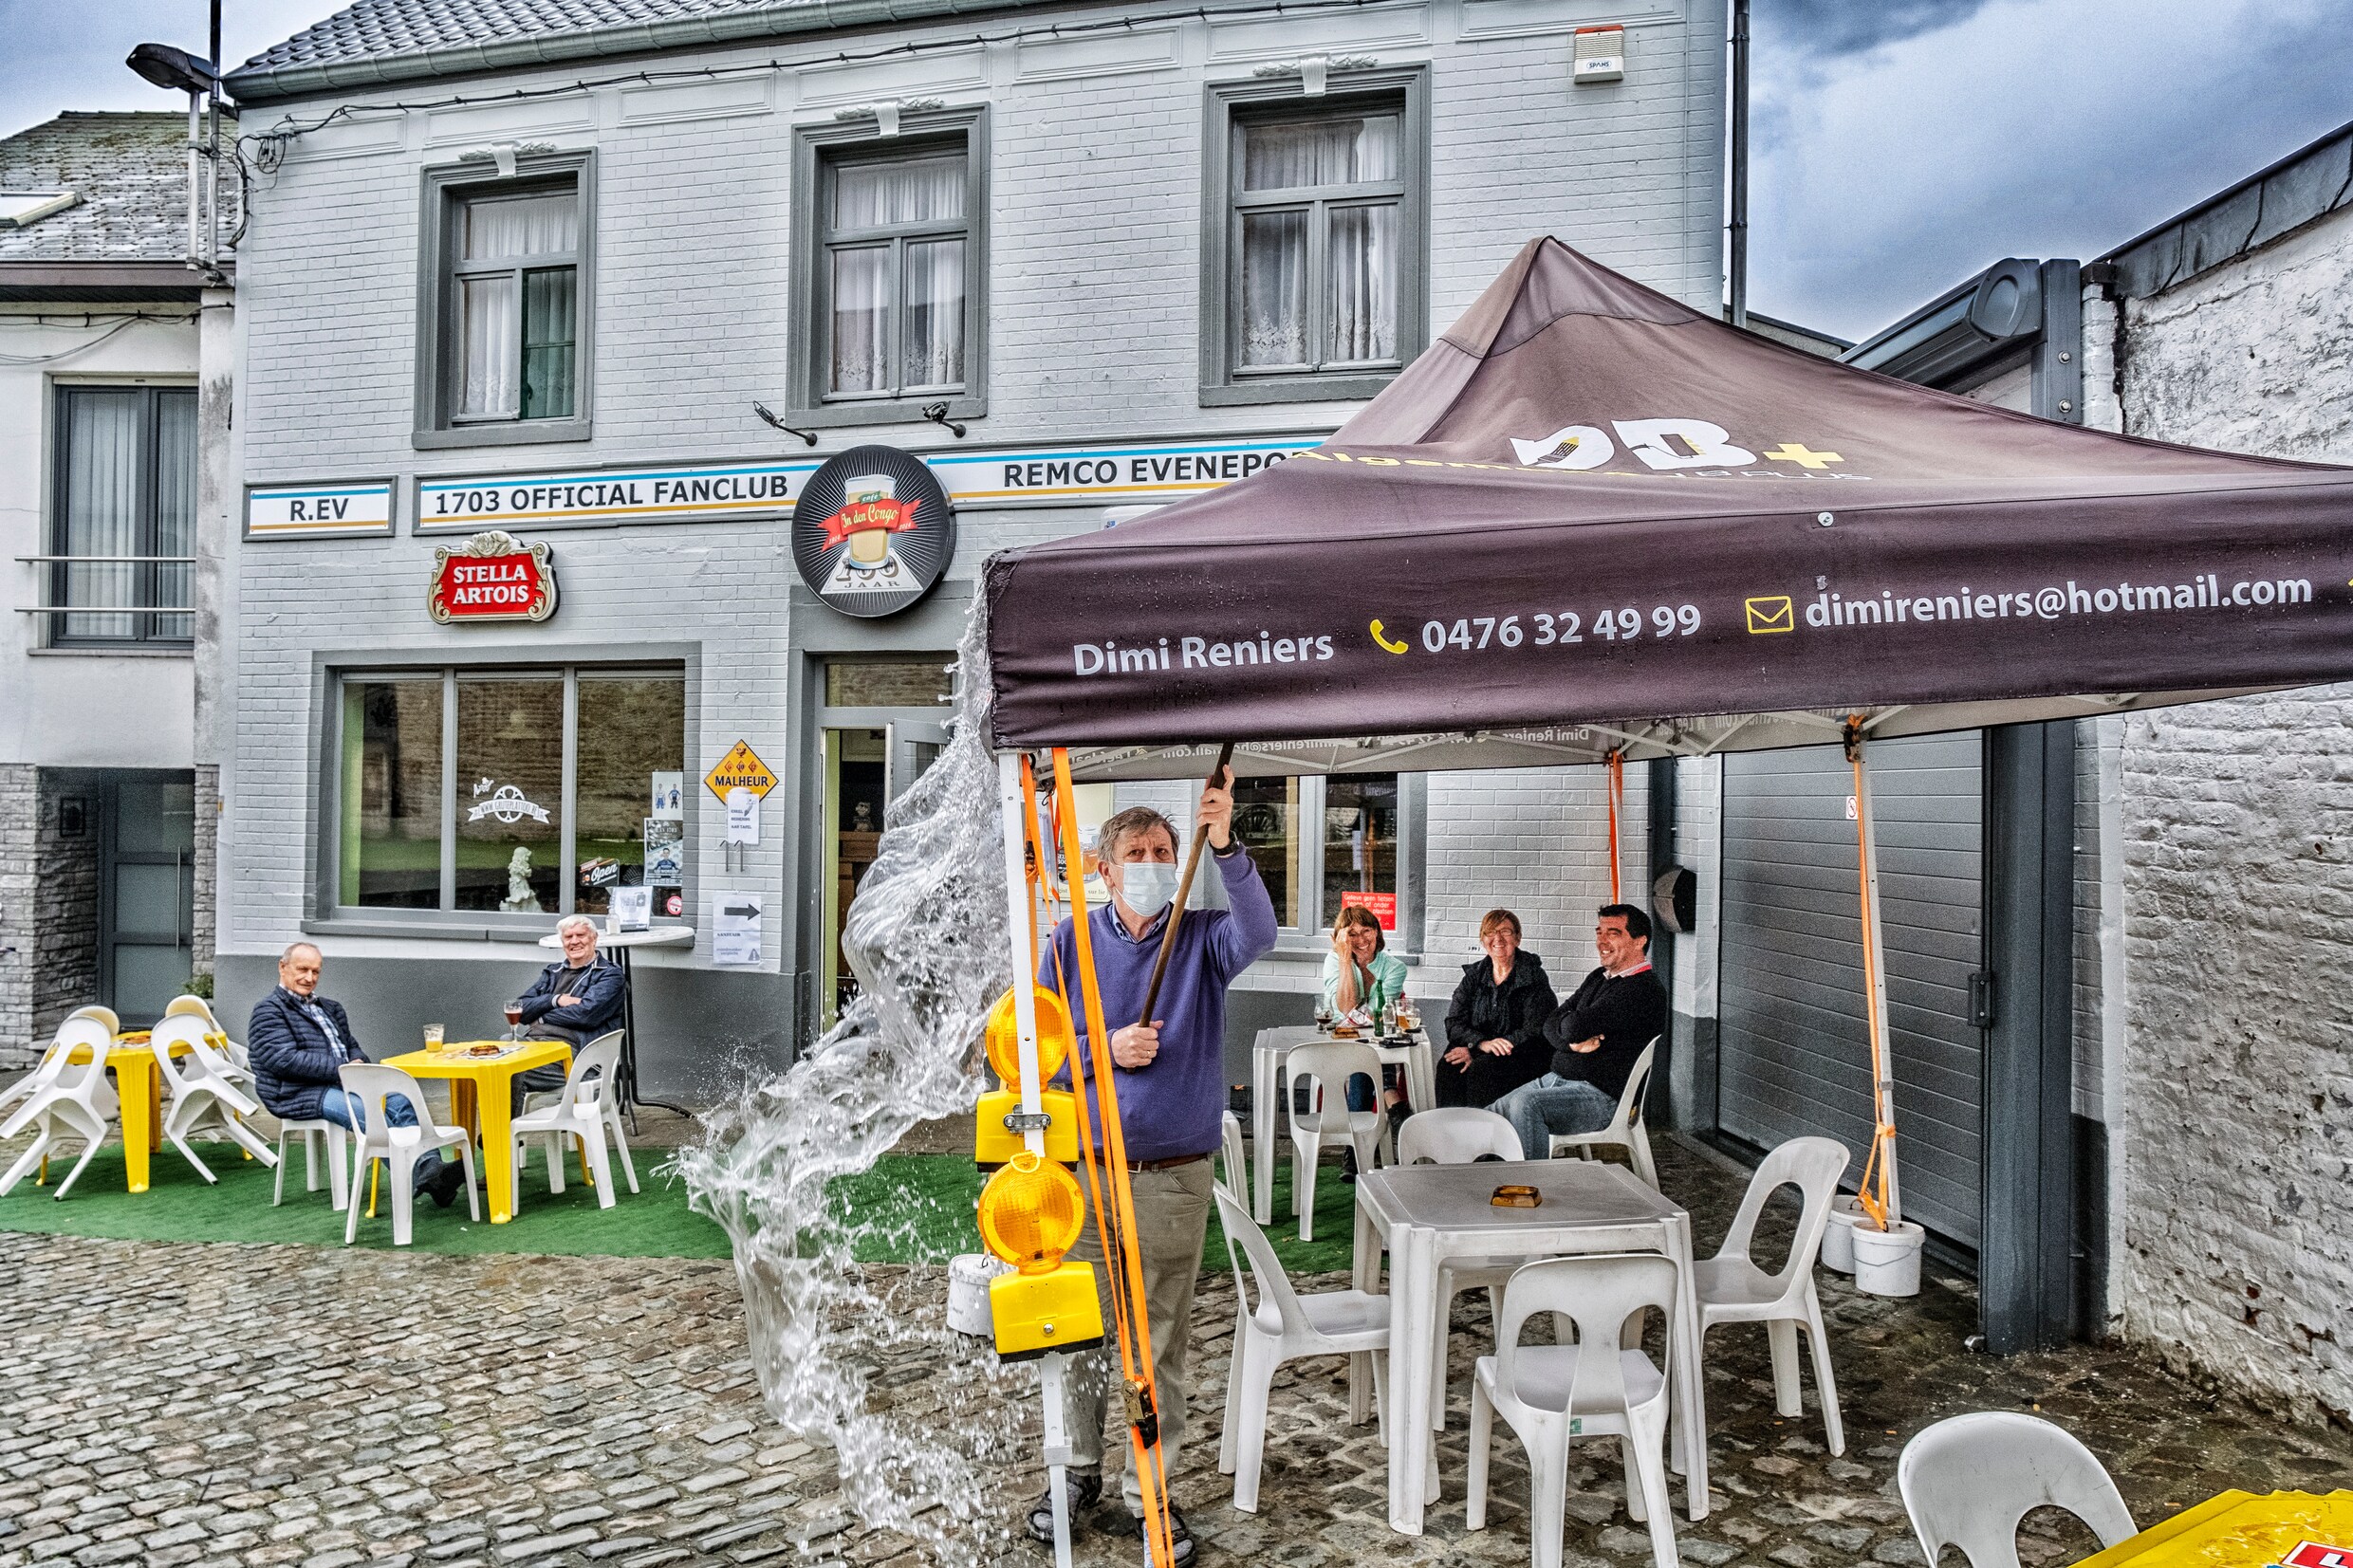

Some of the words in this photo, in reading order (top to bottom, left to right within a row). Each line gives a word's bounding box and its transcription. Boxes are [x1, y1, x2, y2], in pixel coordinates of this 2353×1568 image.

[1004, 460, 1118, 488] REMCO
[1131, 452, 1302, 483] EVENEPO
[435, 489, 500, 514] 1703
[510, 483, 643, 510] OFFICIAL
[655, 475, 788, 504] FANCLUB
[289, 498, 349, 522] R.EV
[842, 512, 852, 527] In
[854, 510, 866, 525] den
[868, 504, 899, 524] Congo
[454, 564, 528, 583] STELLA
[844, 581, 900, 589] JAAR
[453, 585, 529, 604] ARTOIS
[1806, 575, 2312, 627] dimireniers@hotmail.com
[1422, 616, 1523, 653] 0476
[1533, 612, 1583, 645] 32
[1593, 608, 1642, 640] 49
[1652, 604, 1701, 637] 99
[1073, 638, 1170, 676] Dimi
[1181, 631, 1334, 669] Reniers
[714, 776, 769, 787] MALHEUR
[591, 863, 619, 882] Open
